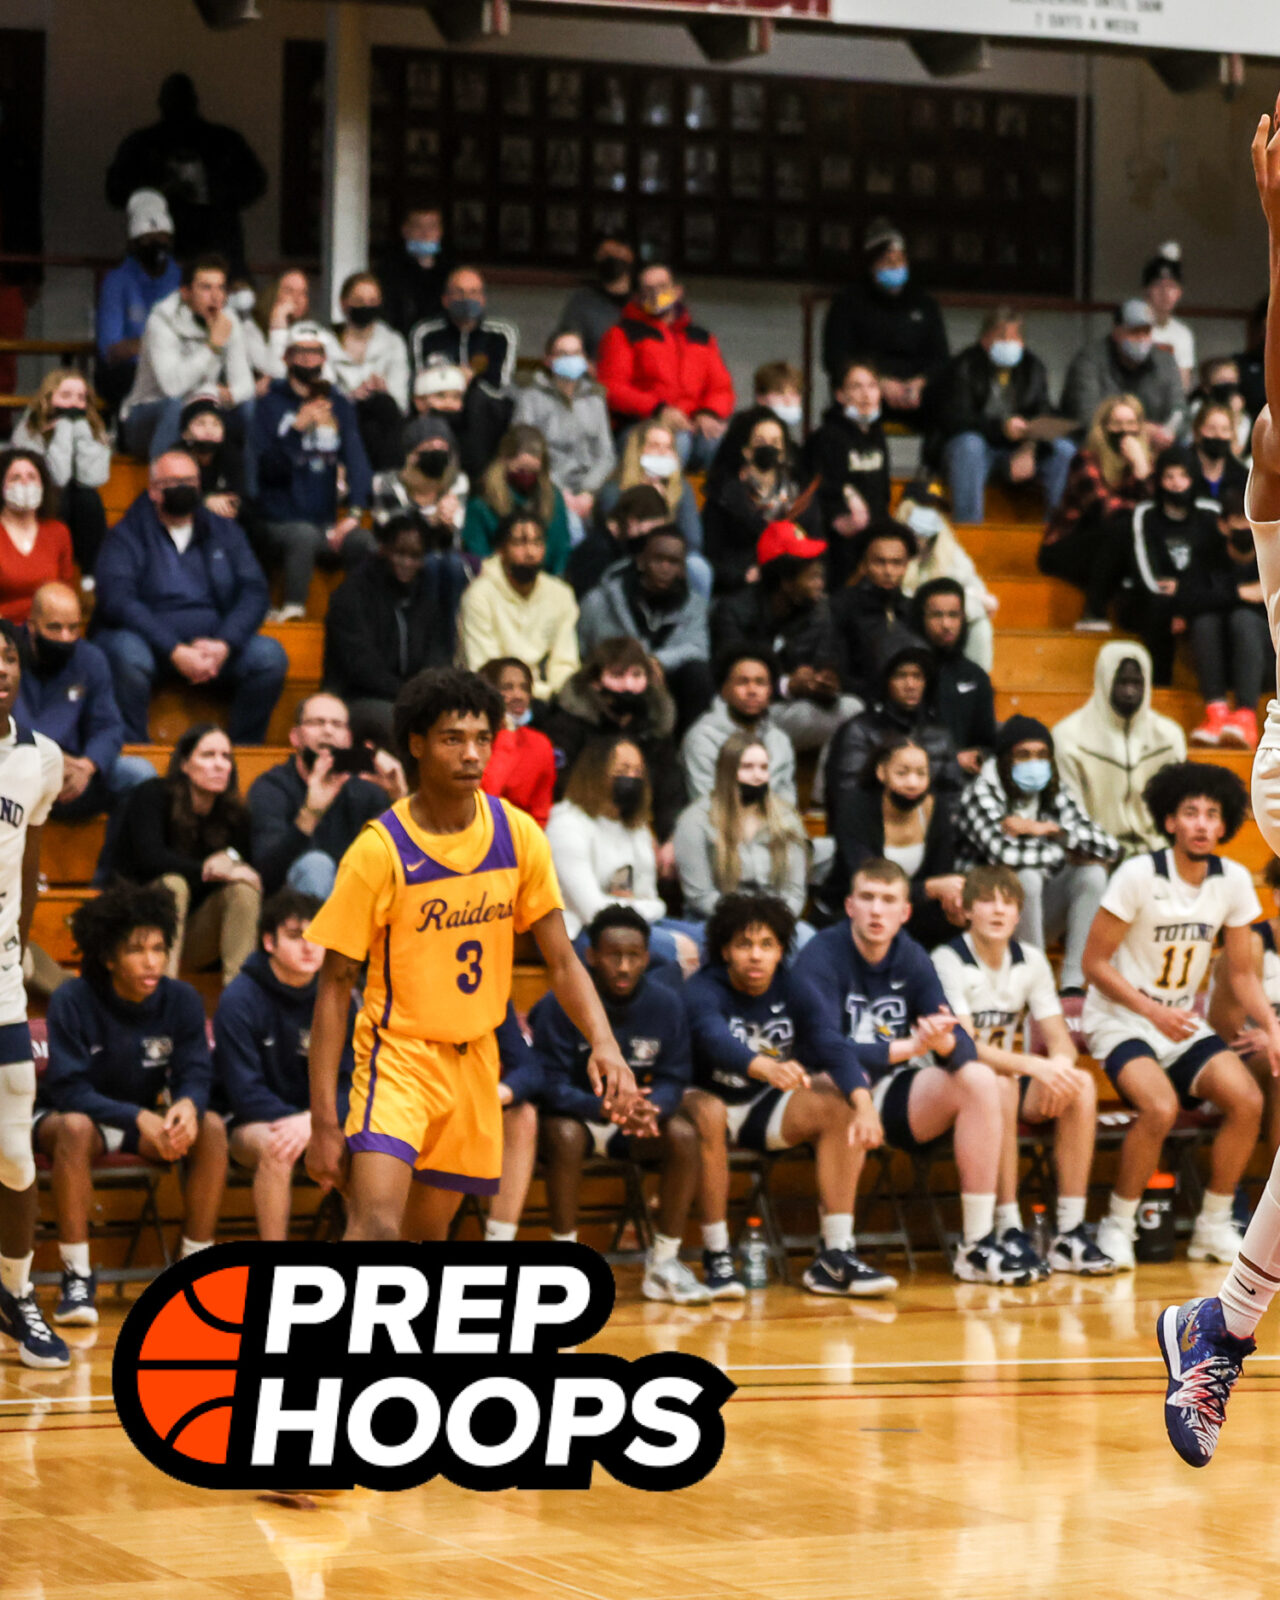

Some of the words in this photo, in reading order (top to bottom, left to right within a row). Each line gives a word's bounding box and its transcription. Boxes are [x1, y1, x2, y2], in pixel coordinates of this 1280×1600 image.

[416, 890, 514, 933] Raiders
[455, 940, 483, 995] 3
[1155, 945, 1196, 990] 11
